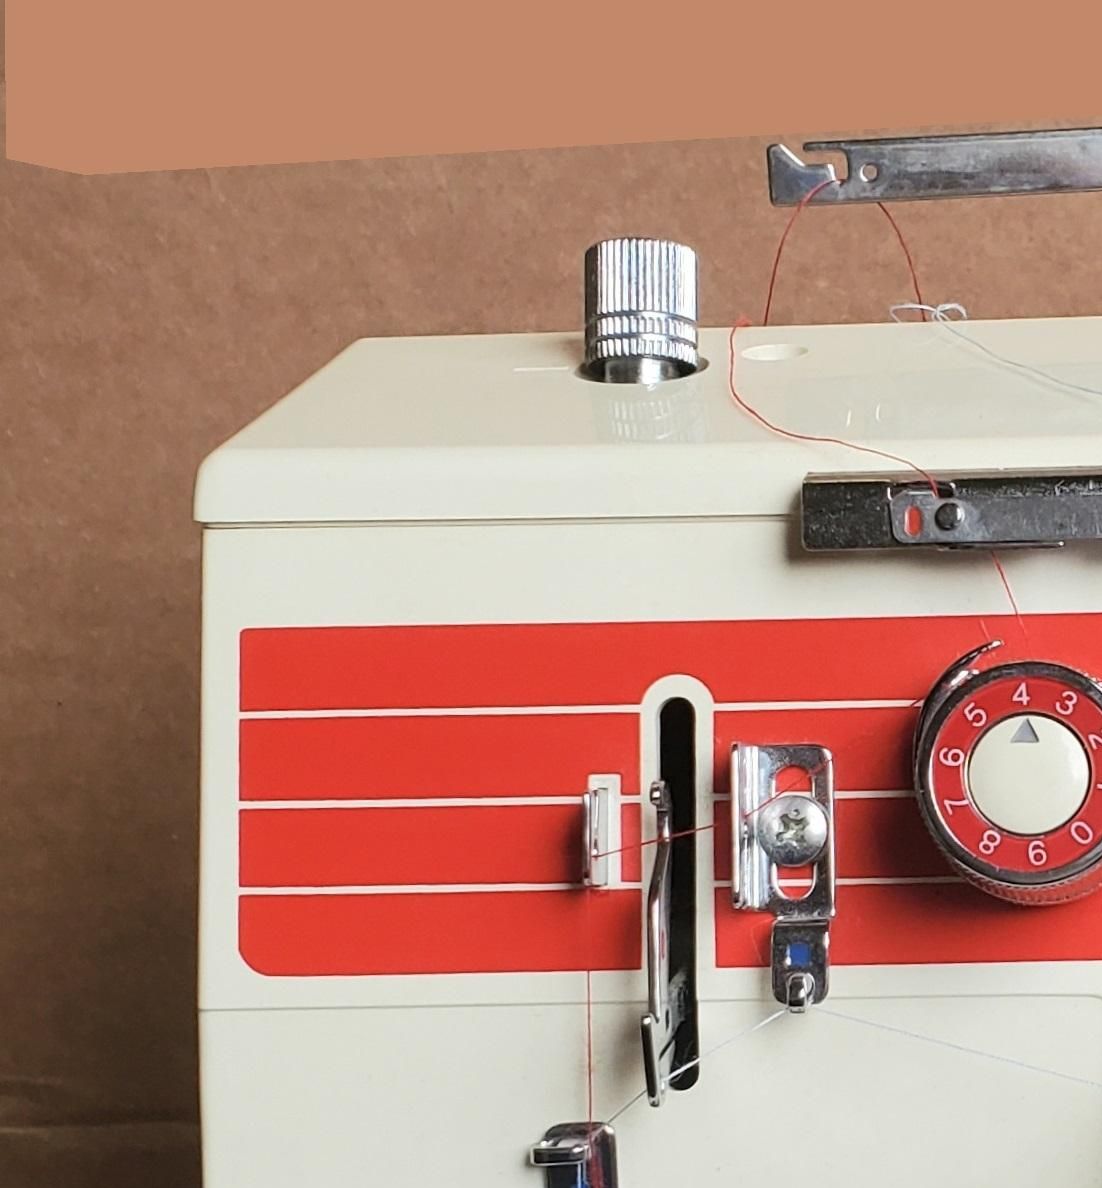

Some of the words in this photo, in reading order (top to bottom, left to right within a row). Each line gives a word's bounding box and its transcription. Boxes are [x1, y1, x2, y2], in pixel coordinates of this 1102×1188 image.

[1012, 682, 1030, 705] 4
[1055, 691, 1078, 715] 3
[964, 703, 987, 727] 5
[944, 798, 969, 815] 7
[979, 830, 1001, 854] 8
[1071, 822, 1093, 844] 0
